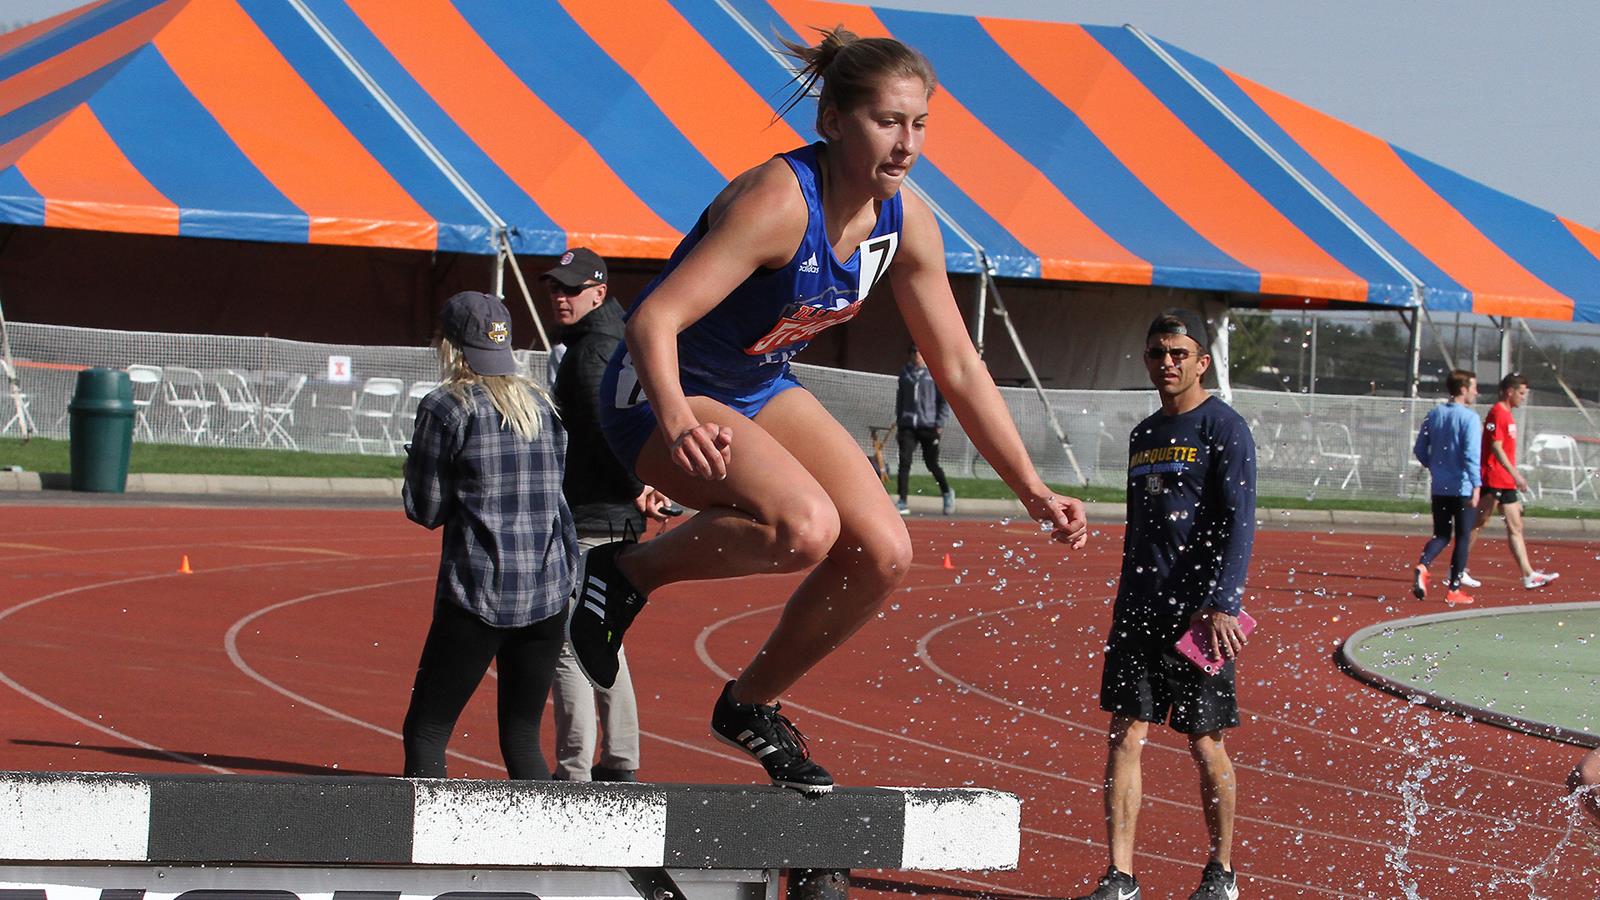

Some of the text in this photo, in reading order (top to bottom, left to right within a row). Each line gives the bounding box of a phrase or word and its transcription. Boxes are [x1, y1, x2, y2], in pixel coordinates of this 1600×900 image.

[798, 264, 820, 274] adidas
[869, 238, 891, 293] 7
[1131, 446, 1198, 467] MARQUETTE
